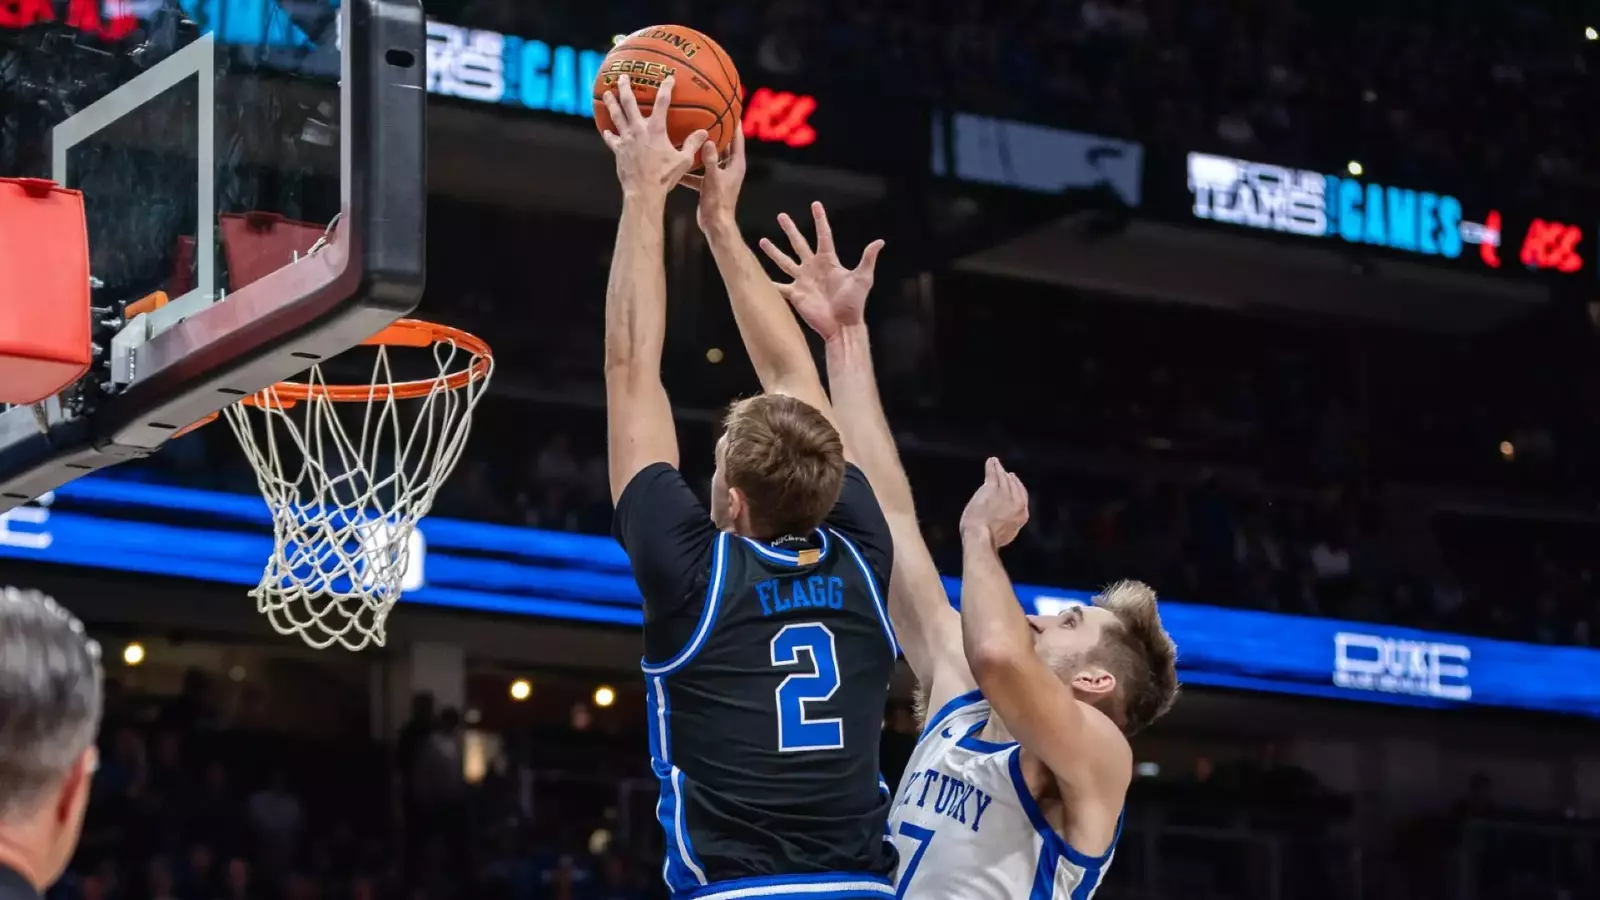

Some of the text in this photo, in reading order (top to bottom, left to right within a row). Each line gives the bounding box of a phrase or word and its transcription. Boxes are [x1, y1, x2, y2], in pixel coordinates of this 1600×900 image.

[1192, 184, 1328, 237] TEAMS
[1339, 177, 1463, 259] GAMES
[755, 575, 845, 617] FLAGG
[770, 621, 844, 752] 2
[1334, 631, 1472, 701] DUKE
[896, 820, 936, 900] 7
